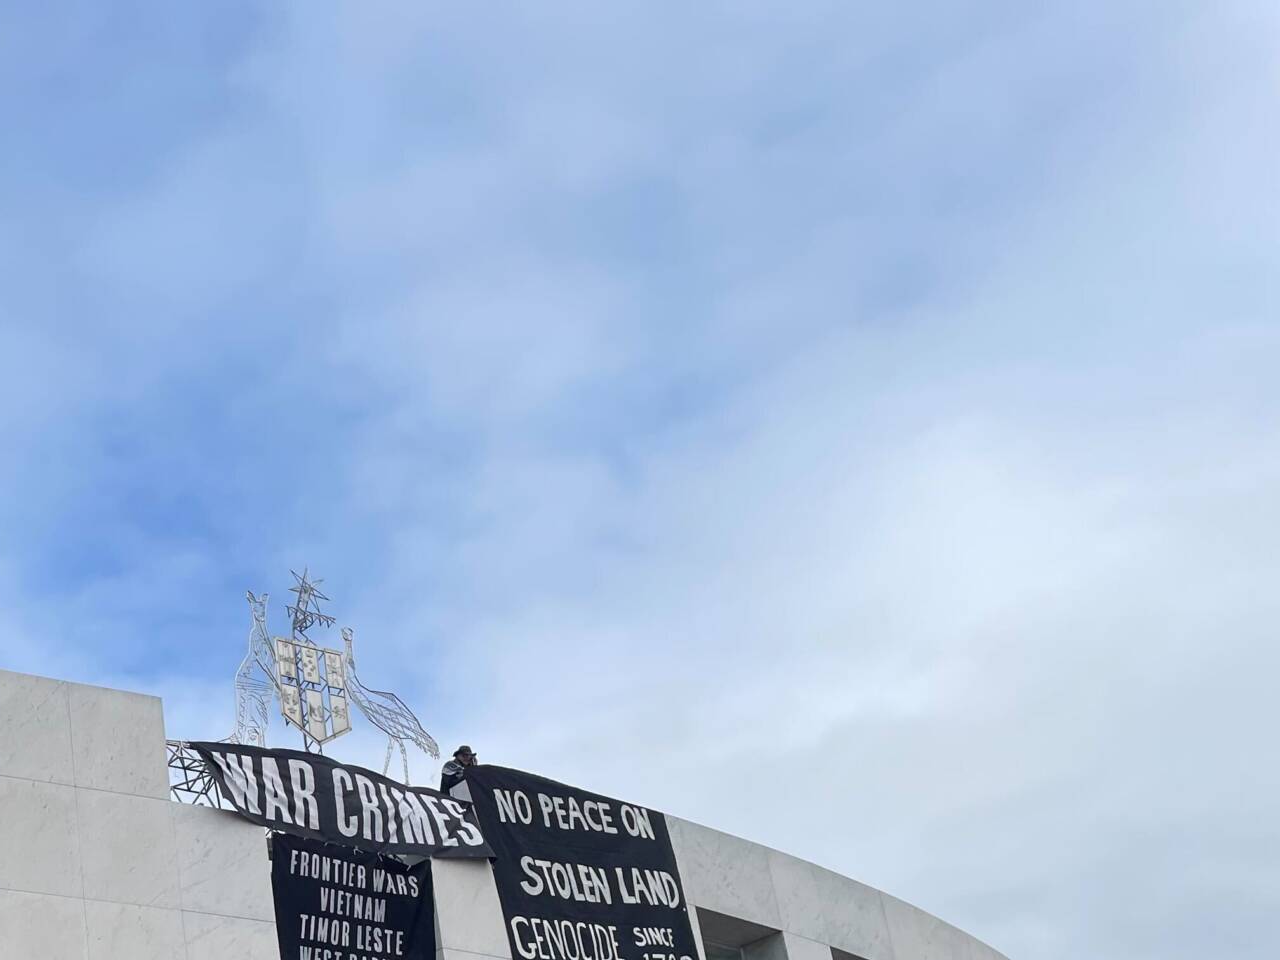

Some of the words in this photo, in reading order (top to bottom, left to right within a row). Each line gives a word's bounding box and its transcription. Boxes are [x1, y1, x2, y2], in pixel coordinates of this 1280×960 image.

[211, 751, 320, 831] WAR
[331, 767, 484, 848] CRIMES
[493, 788, 533, 825] NO
[537, 792, 618, 835] PEACE
[621, 804, 656, 841] ON
[290, 849, 367, 889] FRONTIER
[372, 868, 420, 898] WARS
[520, 855, 613, 905] STOLEN
[320, 886, 387, 923] VIETNAM
[300, 913, 350, 947] TIMOR
[356, 925, 405, 956] LESTE
[633, 927, 674, 948] SINCE
